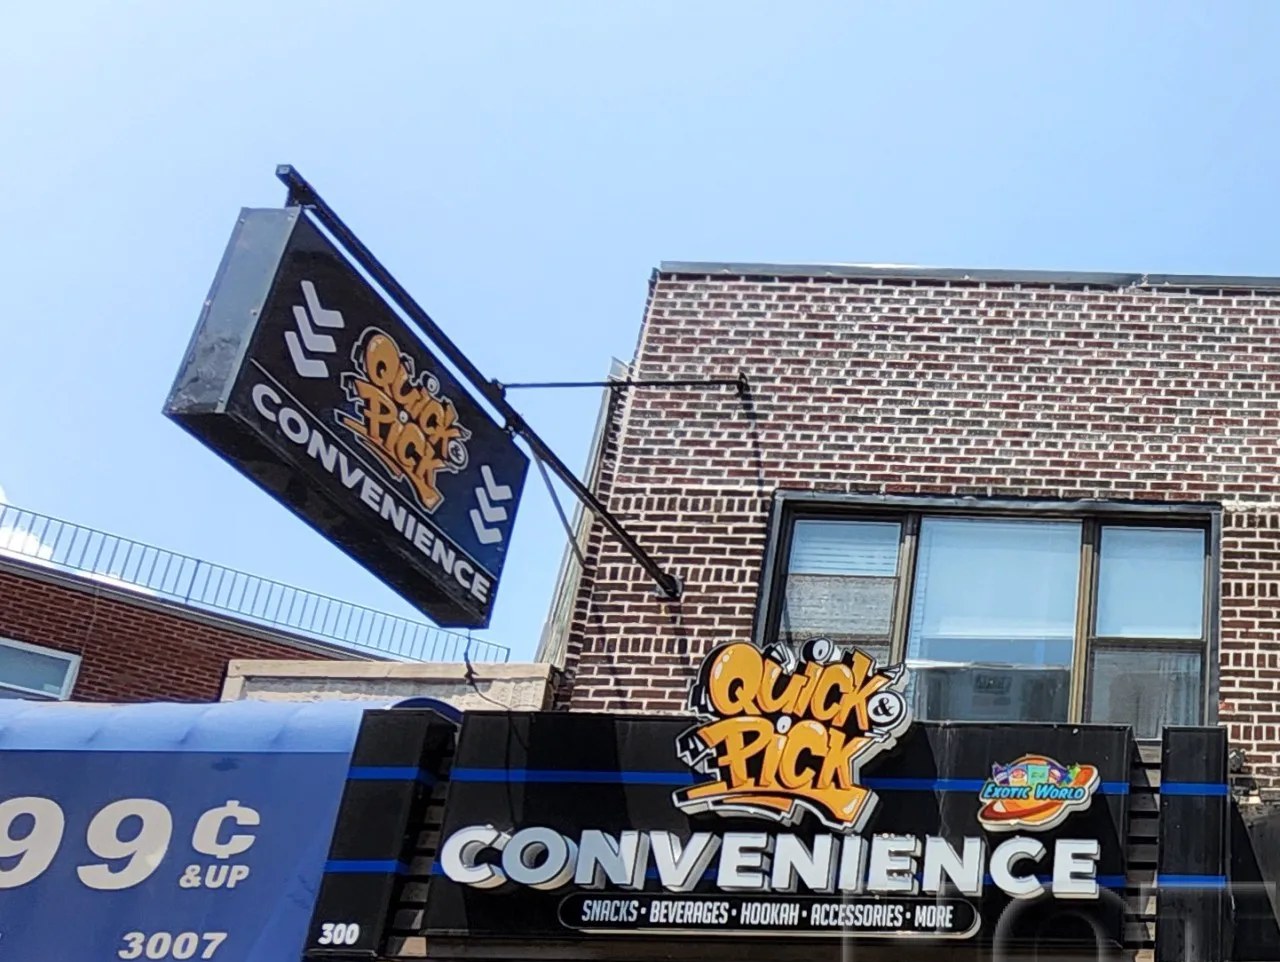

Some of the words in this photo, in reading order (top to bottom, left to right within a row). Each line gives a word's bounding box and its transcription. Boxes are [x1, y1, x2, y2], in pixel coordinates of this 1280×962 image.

[354, 378, 447, 484] PICK
[252, 384, 490, 603] CONVENIENCE
[709, 638, 890, 730] QUICK
[697, 715, 873, 790] PICK
[983, 782, 1032, 799] EXOTIC
[1034, 783, 1085, 799] WORLD
[180, 864, 249, 888] &UP
[441, 826, 1101, 899] CONVENIENCE
[318, 922, 360, 945] 300
[581, 900, 638, 922] SNACKS
[649, 902, 729, 923] BEVERAGES
[740, 903, 799, 925] HOOKAH
[810, 904, 903, 926] ACCESSORIES
[914, 905, 953, 928] MORE
[118, 932, 227, 960] 3007
